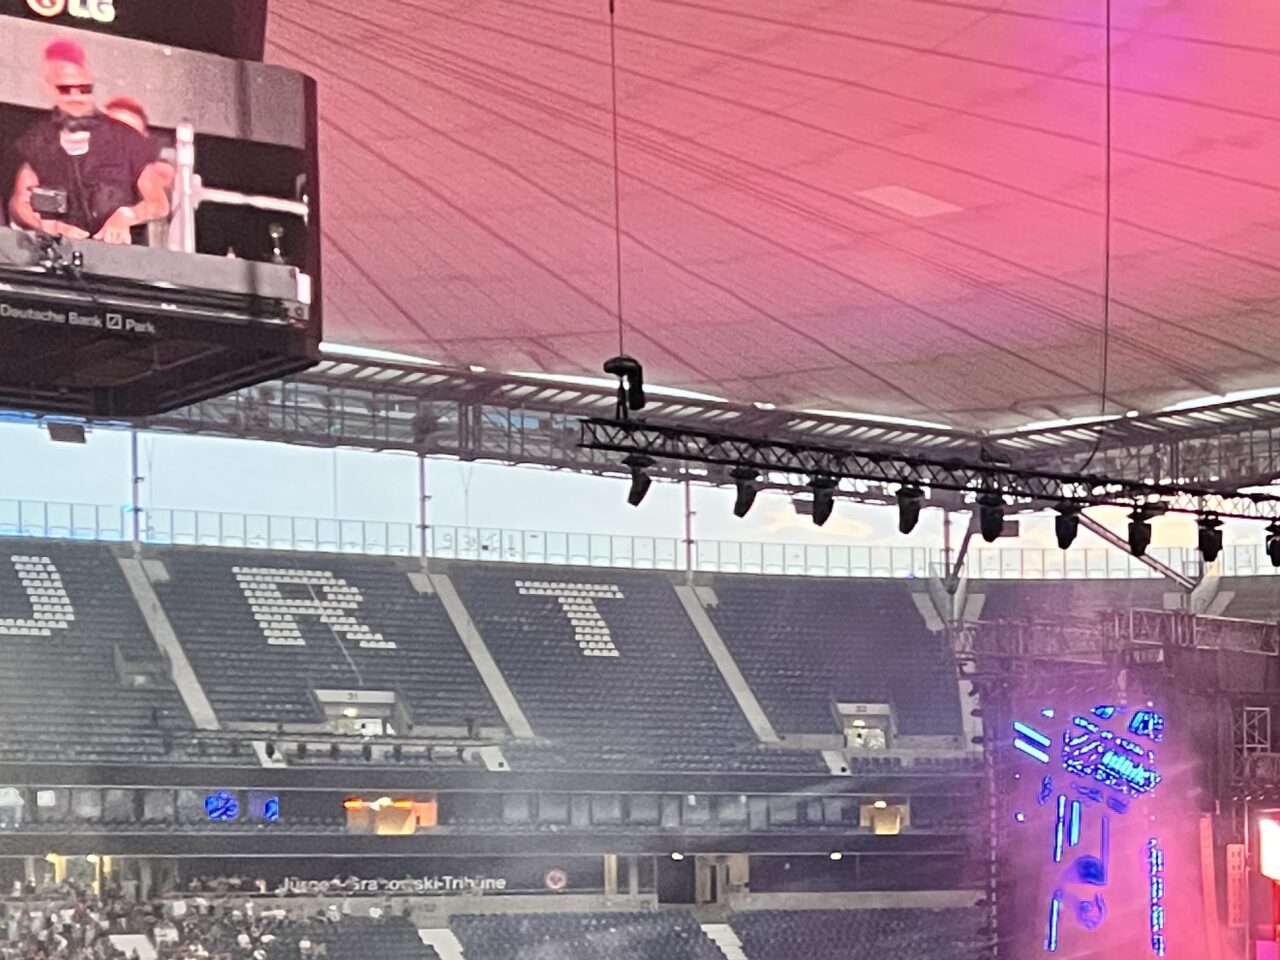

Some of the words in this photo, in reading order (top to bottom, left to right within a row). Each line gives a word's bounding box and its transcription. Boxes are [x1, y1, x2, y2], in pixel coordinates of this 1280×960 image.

[0, 303, 66, 323] Deutsche
[68, 311, 103, 328] Bank
[125, 318, 156, 334] Park
